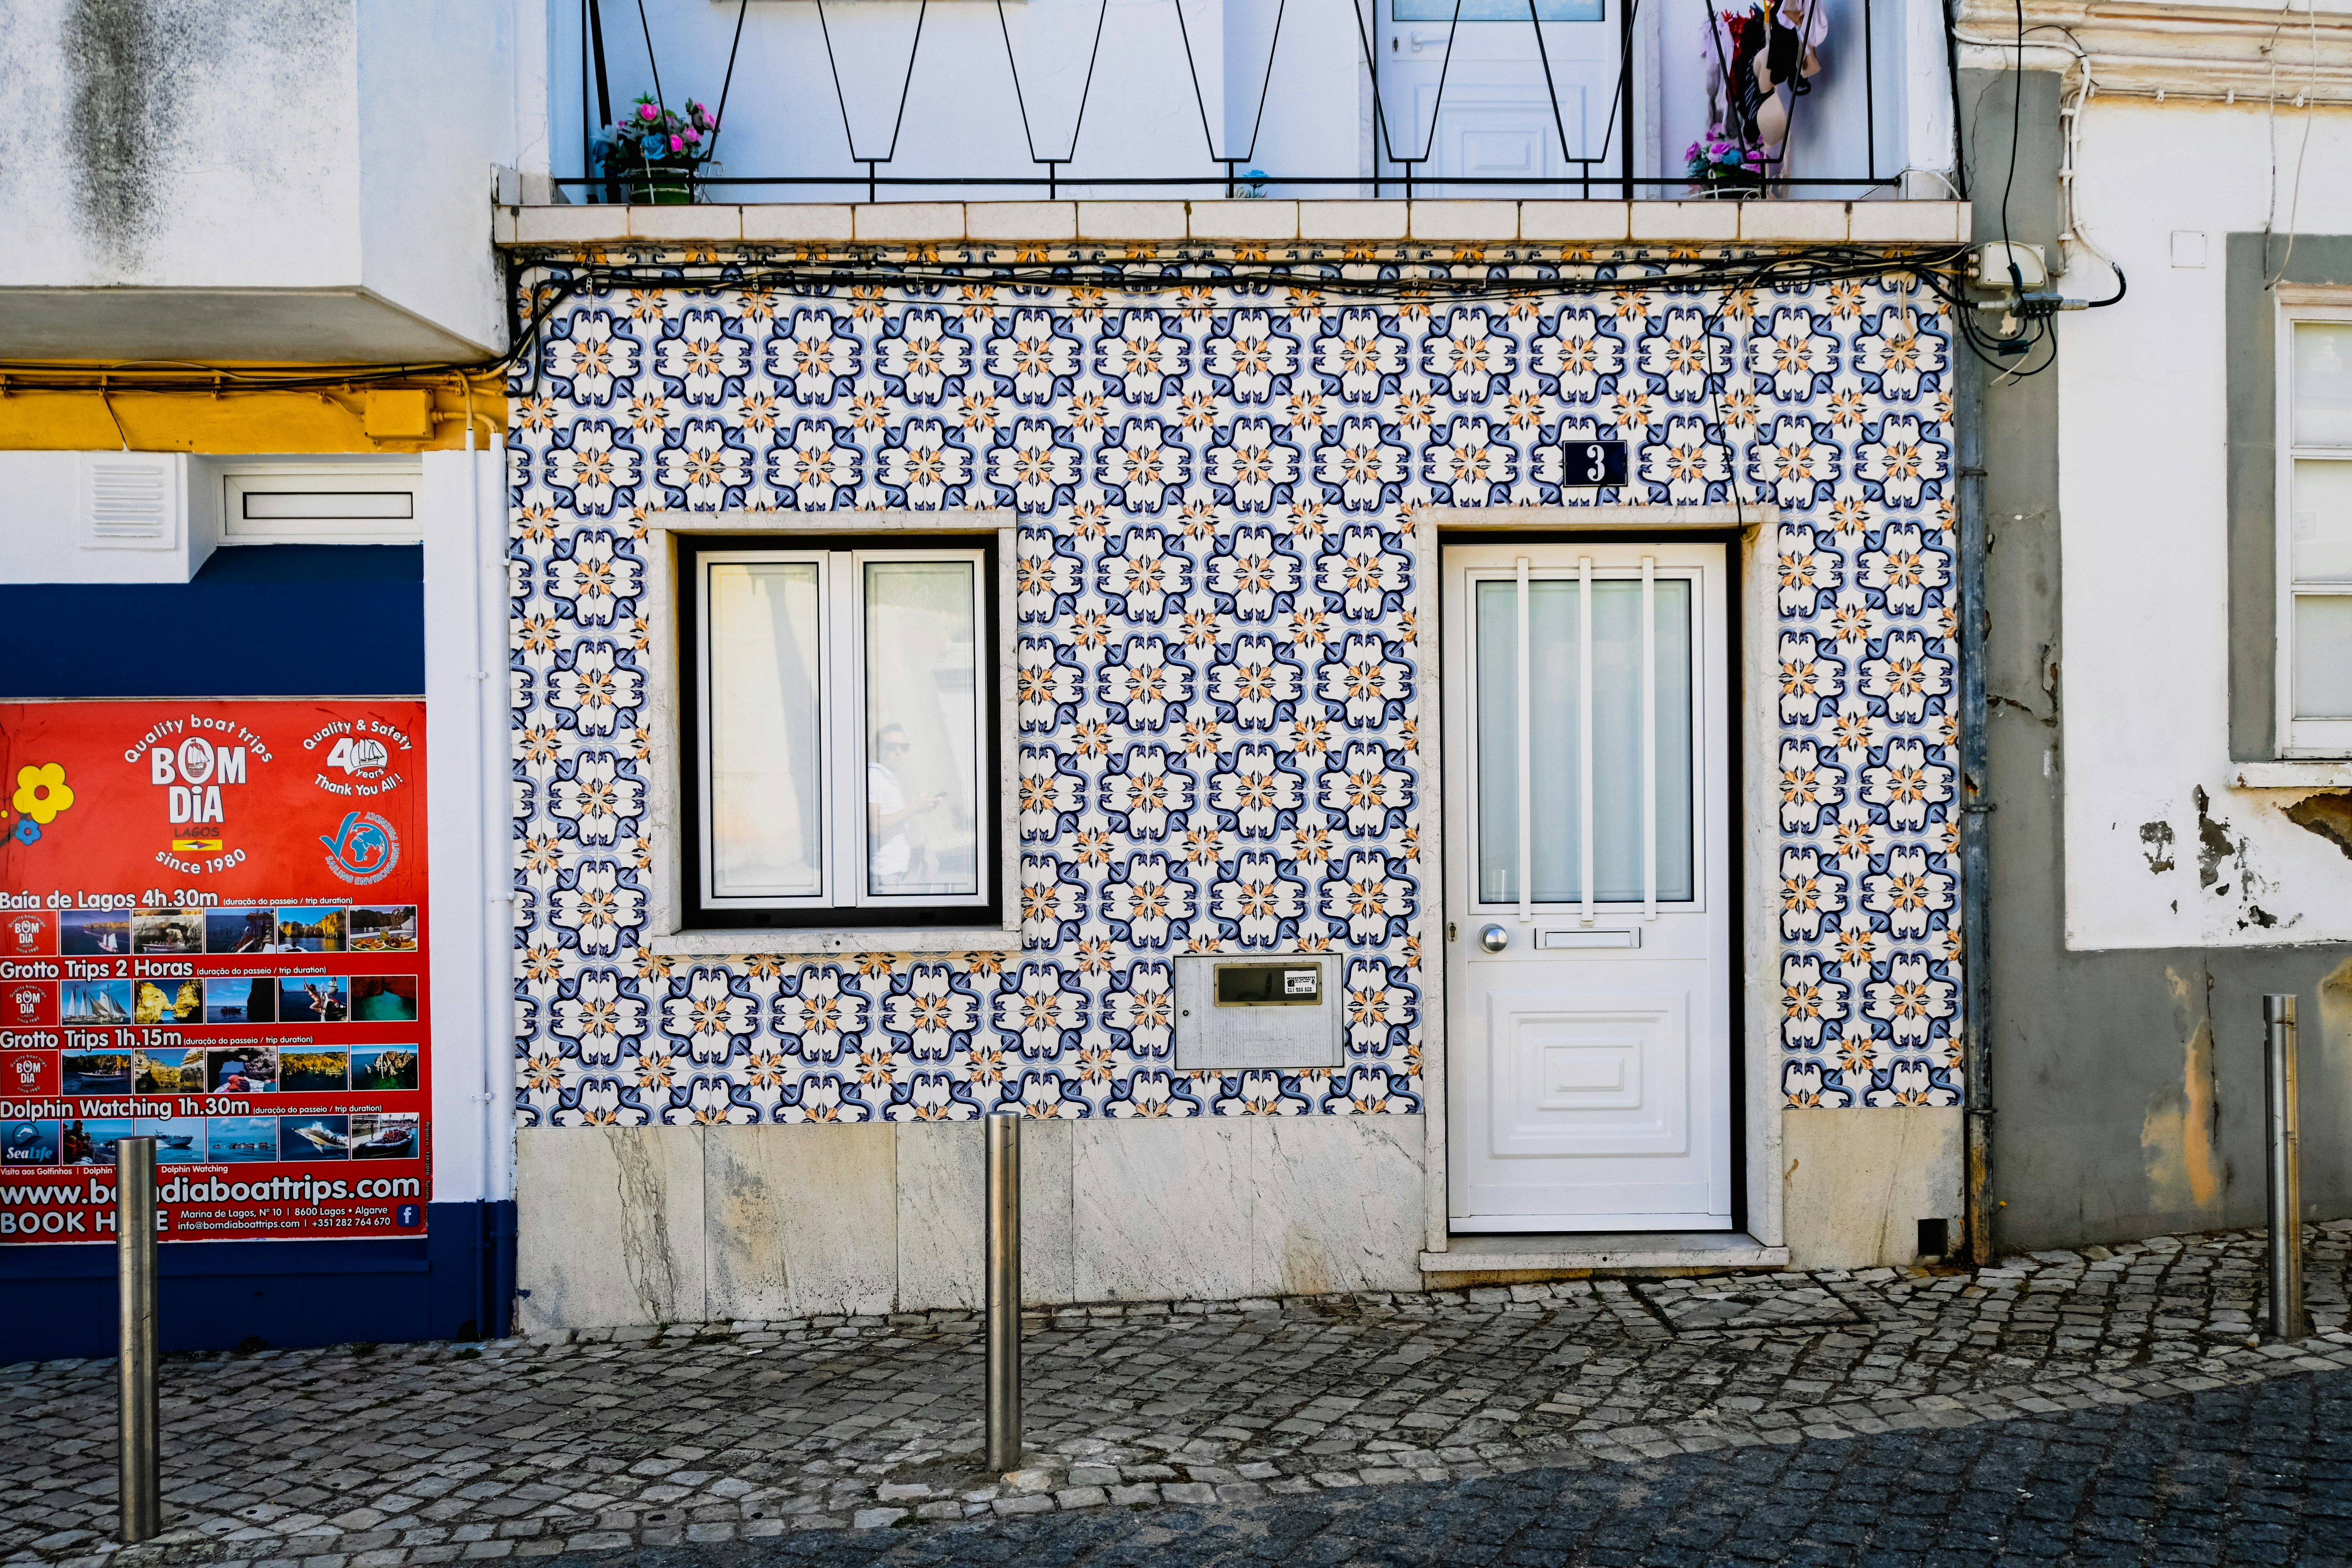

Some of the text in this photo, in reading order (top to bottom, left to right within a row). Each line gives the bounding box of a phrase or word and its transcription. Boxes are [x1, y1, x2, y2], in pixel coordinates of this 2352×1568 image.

[1587, 445, 1605, 482] 3
[125, 714, 272, 762] Quality boat trips
[303, 719, 412, 750] Quality & Safety
[152, 737, 246, 784] BOM
[355, 768, 384, 778] years
[315, 773, 351, 795] Thank
[356, 784, 378, 795] You
[381, 776, 397, 792] All
[174, 827, 220, 837] LAGOS
[325, 811, 399, 885] SAILING ENVIRONMENT FRIENDLY
[155, 849, 246, 874] since 1980
[0, 890, 40, 909] Baía
[47, 890, 72, 908] de
[79, 890, 136, 912] Lagos
[142, 888, 218, 907] 4h.30m
[223, 898, 256, 906] (duração
[270, 897, 298, 906] passeio
[305, 897, 317, 906] trip
[15, 920, 39, 933] BOM
[37, 917, 46, 927] trips
[0, 961, 59, 979] Grotto
[65, 959, 109, 982] Trips
[116, 959, 128, 976] 2
[135, 959, 193, 976] Horas
[197, 968, 230, 976] (duração
[244, 967, 271, 975] passeio
[279, 967, 291, 975] trip
[16, 991, 40, 1003] BOM
[38, 988, 46, 997] trips
[0, 1031, 58, 1048] Grotto
[64, 1029, 109, 1051] Trips
[115, 1028, 181, 1046] 1h.15m
[184, 1037, 216, 1045] (duração
[230, 1037, 258, 1045] passeio
[266, 1037, 278, 1045] trip
[16, 1060, 41, 1073] BOM
[38, 1057, 47, 1067] trips
[1, 1100, 73, 1122] Dolphin
[80, 1098, 172, 1120] Watching
[179, 1097, 249, 1115] 1h.30m
[254, 1107, 285, 1115] (duração
[299, 1106, 327, 1114] passeio
[335, 1105, 347, 1113] trip
[6, 1146, 52, 1162] SeaLife
[37, 1167, 72, 1175] Golfinhos
[84, 1167, 112, 1176] Dolphin
[161, 1165, 228, 1174] Dolphin Watching
[0, 1175, 420, 1206] www.bdiaboattrips.com
[0, 1210, 168, 1233] BOOK HE
[181, 1210, 212, 1218] Marina
[215, 1209, 226, 1217] de
[229, 1209, 256, 1219] Lagos,
[295, 1207, 317, 1216] 8600
[320, 1208, 345, 1217] Lagos
[355, 1206, 388, 1216] Algarve
[178, 1220, 299, 1230] info@bomdiaboattrips.com
[312, 1219, 332, 1227] +351
[336, 1219, 352, 1227] 282
[374, 1217, 390, 1225] 670
